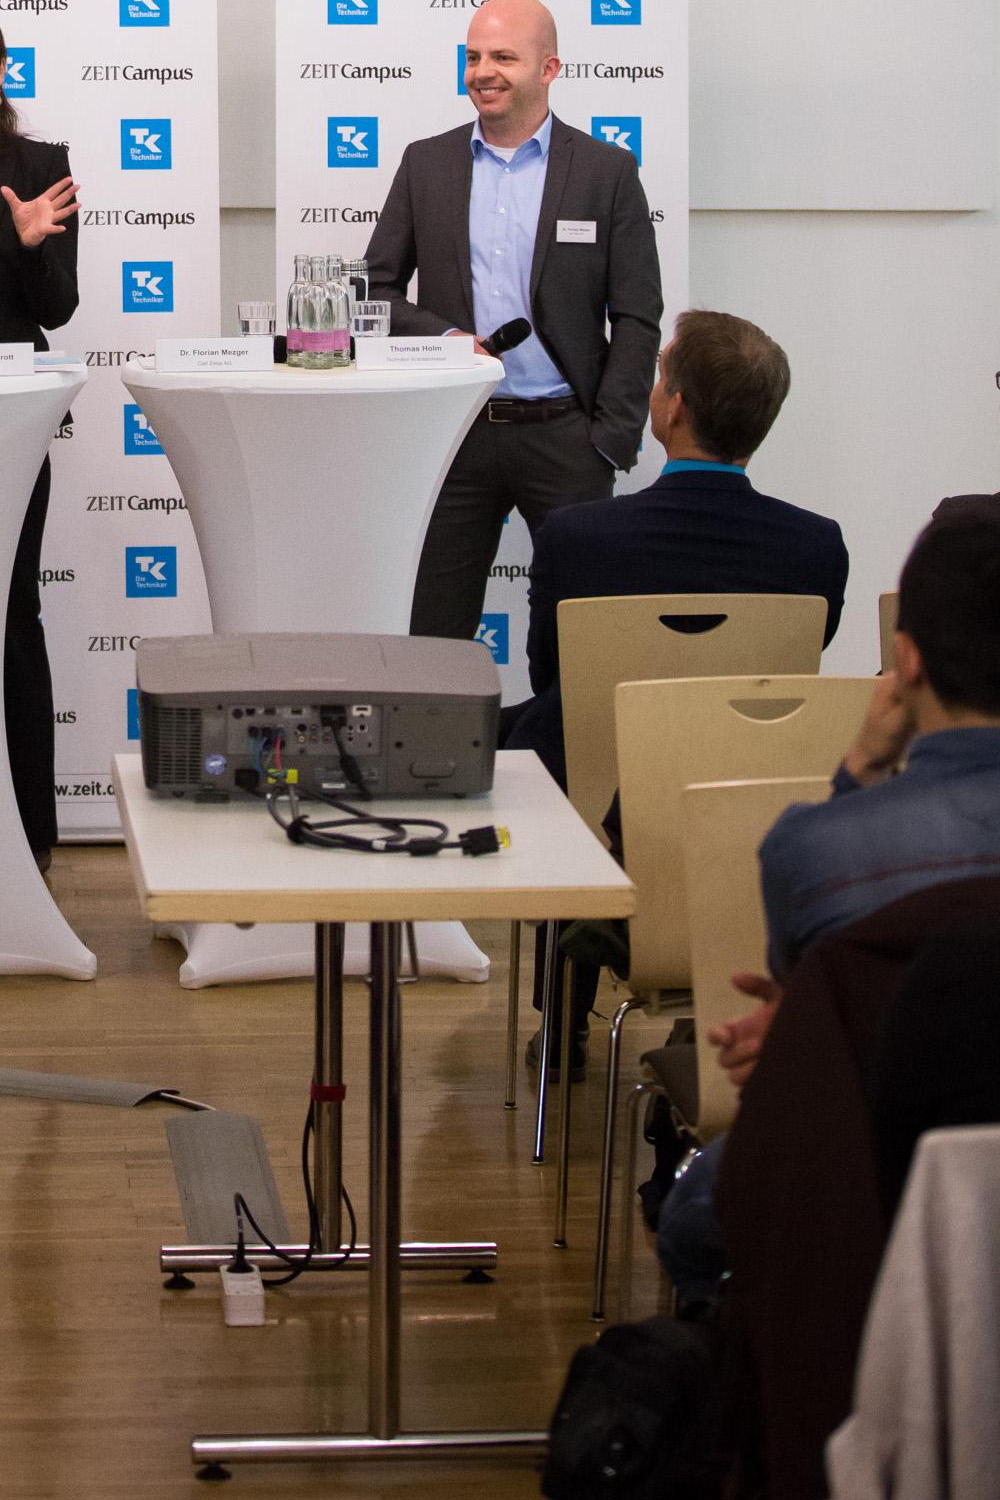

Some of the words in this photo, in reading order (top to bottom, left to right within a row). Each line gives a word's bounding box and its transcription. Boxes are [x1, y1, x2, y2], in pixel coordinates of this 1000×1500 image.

[130, 128, 162, 153] TK
[337, 126, 369, 151] TK
[341, 207, 379, 223] Cam
[132, 271, 164, 296] TK
[222, 349, 248, 357] Mezger
[128, 495, 188, 515] Campu
[135, 557, 167, 582] TK
